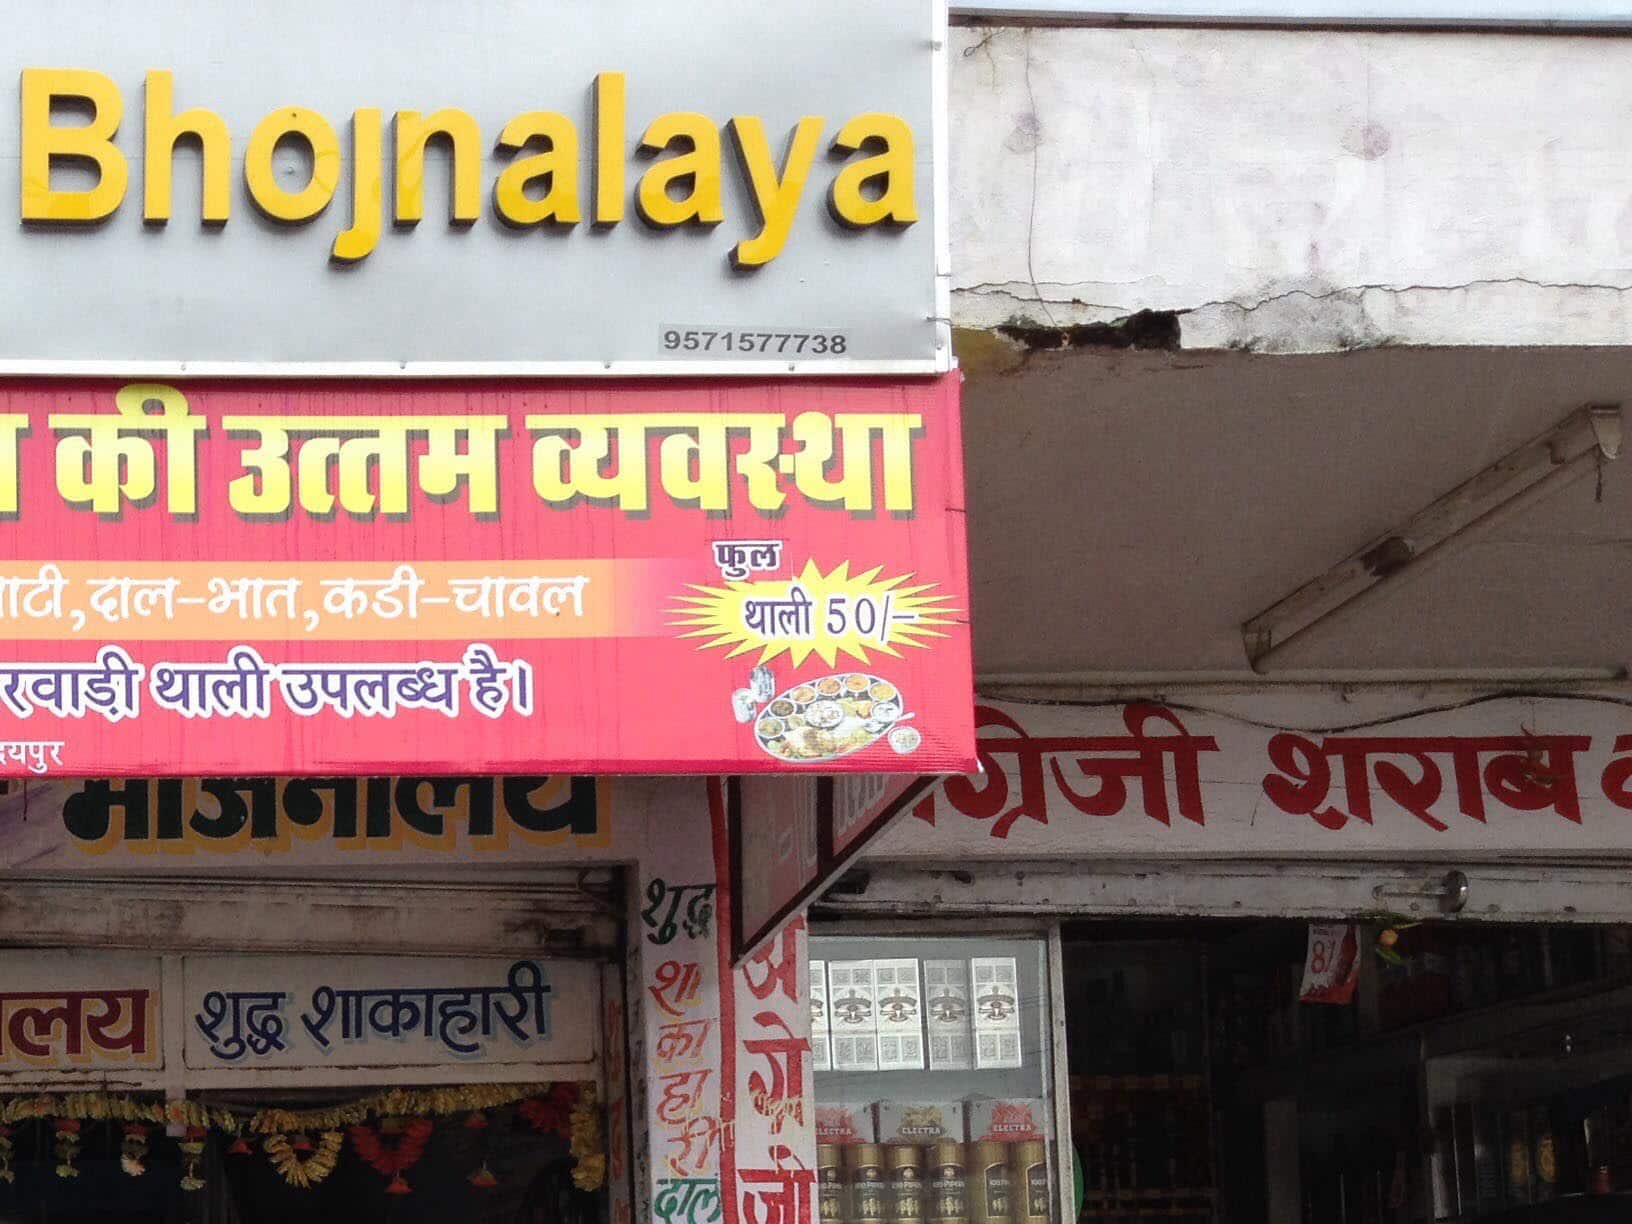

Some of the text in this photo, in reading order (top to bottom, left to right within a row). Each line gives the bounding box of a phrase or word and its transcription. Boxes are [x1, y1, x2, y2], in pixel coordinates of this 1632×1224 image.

[21, 66, 919, 268] Bhojnalaya
[662, 329, 848, 357] 9571577738
[49, 382, 210, 522] की
[221, 412, 510, 520] उत्तम
[526, 411, 924, 520] व्यवस्था
[714, 539, 783, 579] फुल
[742, 588, 919, 644] थाली 50/-
[152, 648, 273, 717] थाली
[281, 659, 458, 718] उपलब्ध
[1264, 731, 1592, 832] शराब
[195, 959, 552, 1060] शुद्ध शाकाहारी
